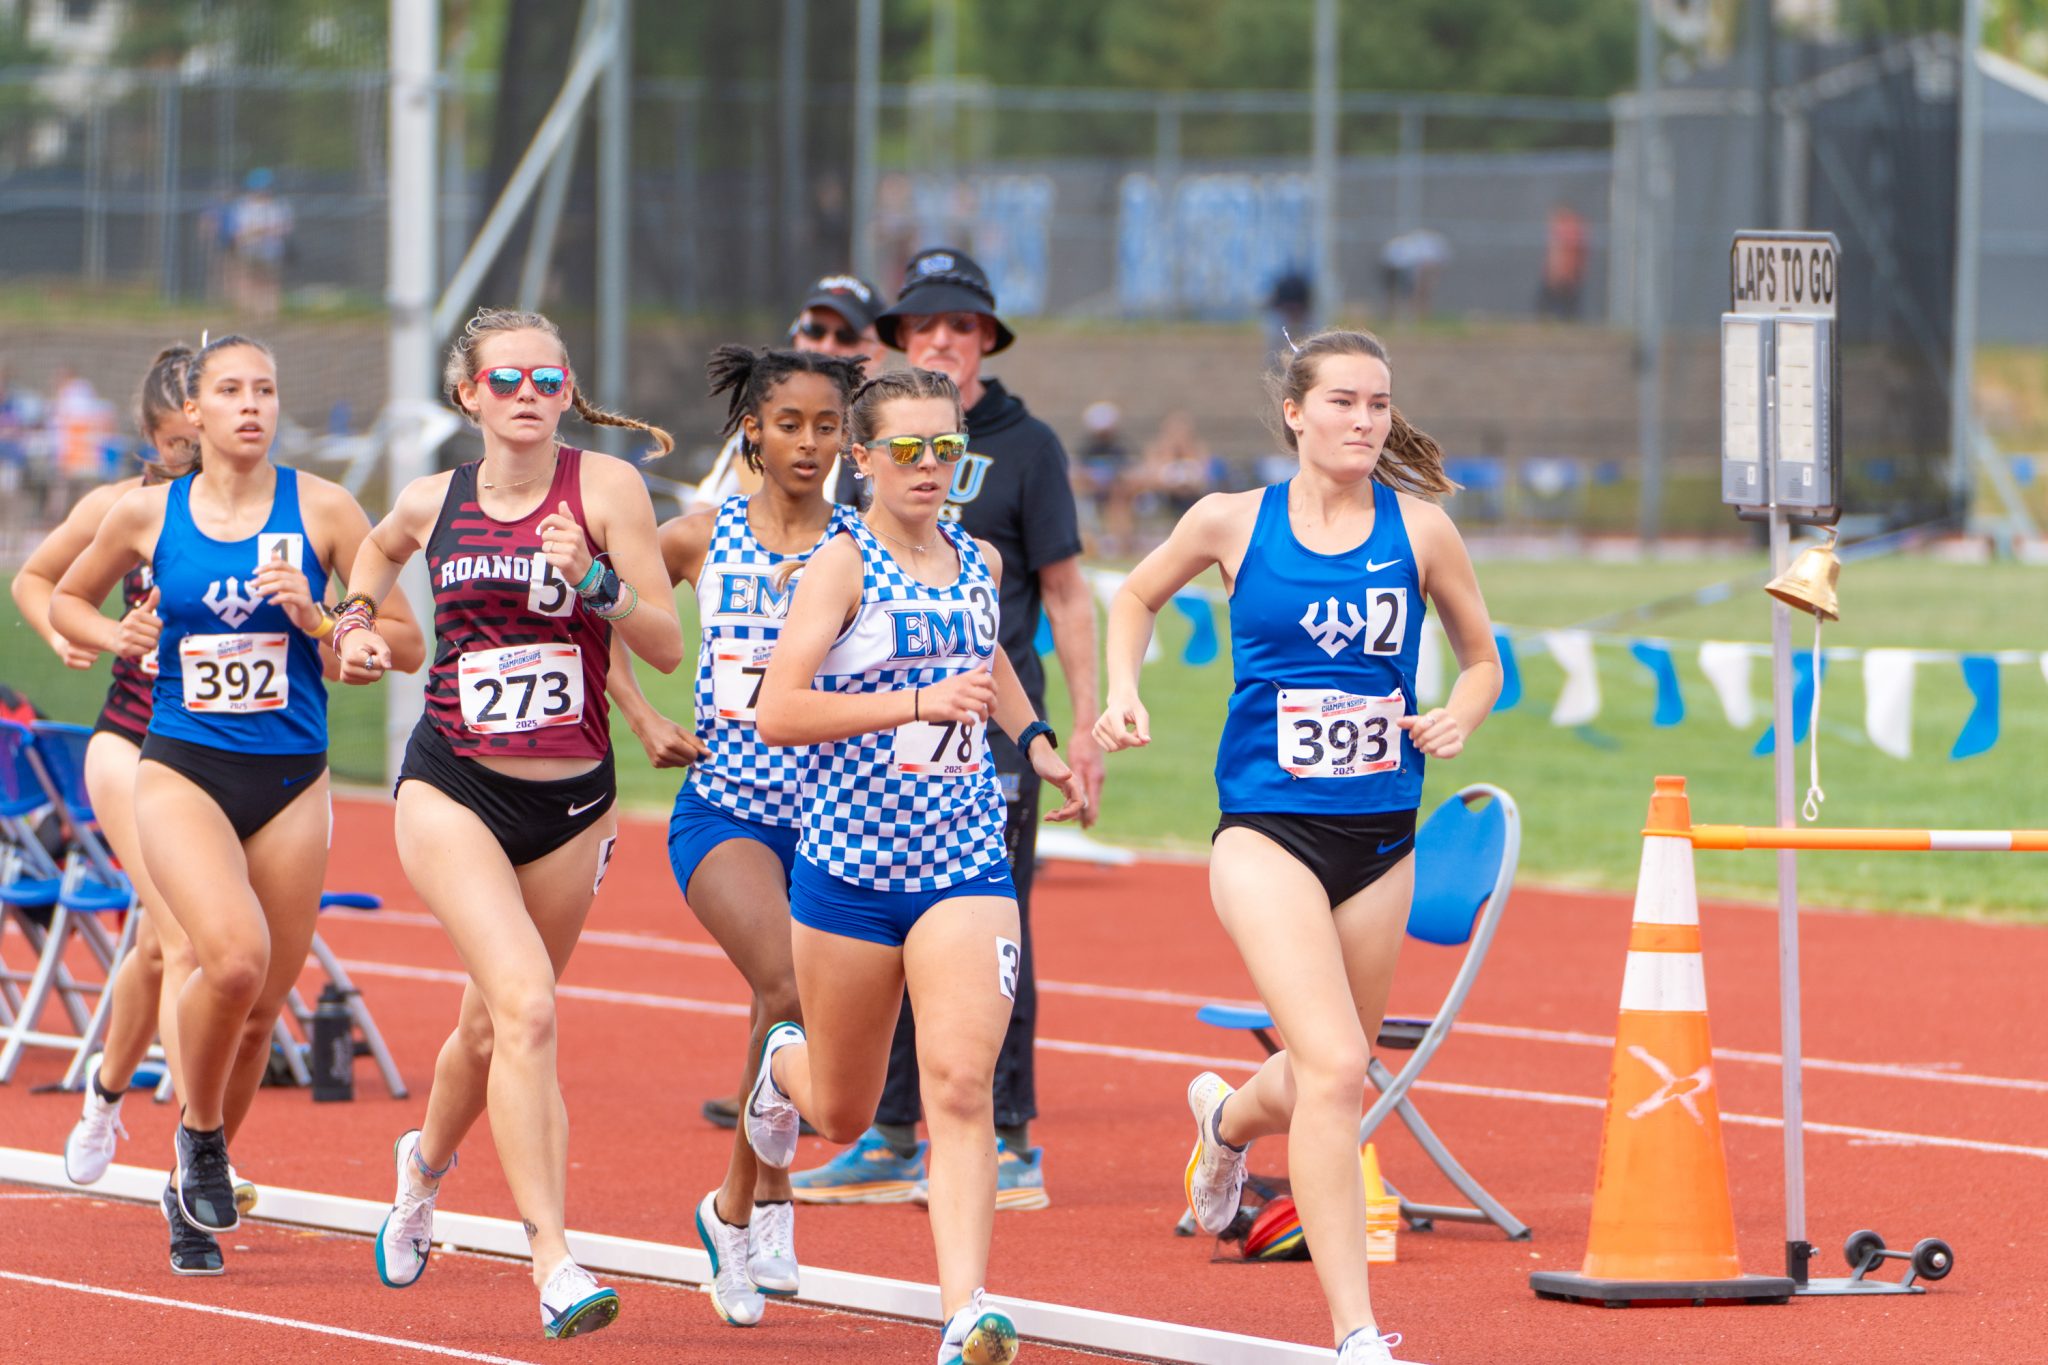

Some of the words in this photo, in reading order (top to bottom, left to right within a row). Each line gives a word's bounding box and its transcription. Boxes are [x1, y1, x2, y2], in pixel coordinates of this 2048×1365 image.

[1734, 246, 1776, 303] LAPS
[1781, 247, 1803, 303] TO
[1809, 248, 1834, 304] GO
[441, 555, 534, 589] ROANO
[712, 571, 799, 620] EM
[969, 586, 996, 641] 3
[1373, 592, 1399, 652] 2
[195, 659, 278, 701] 392
[473, 671, 572, 723] 273
[515, 719, 538, 729] 2025
[928, 720, 973, 763] 78
[1292, 717, 1388, 766] 393
[944, 765, 962, 774] 2025
[1333, 766, 1355, 775] 2025
